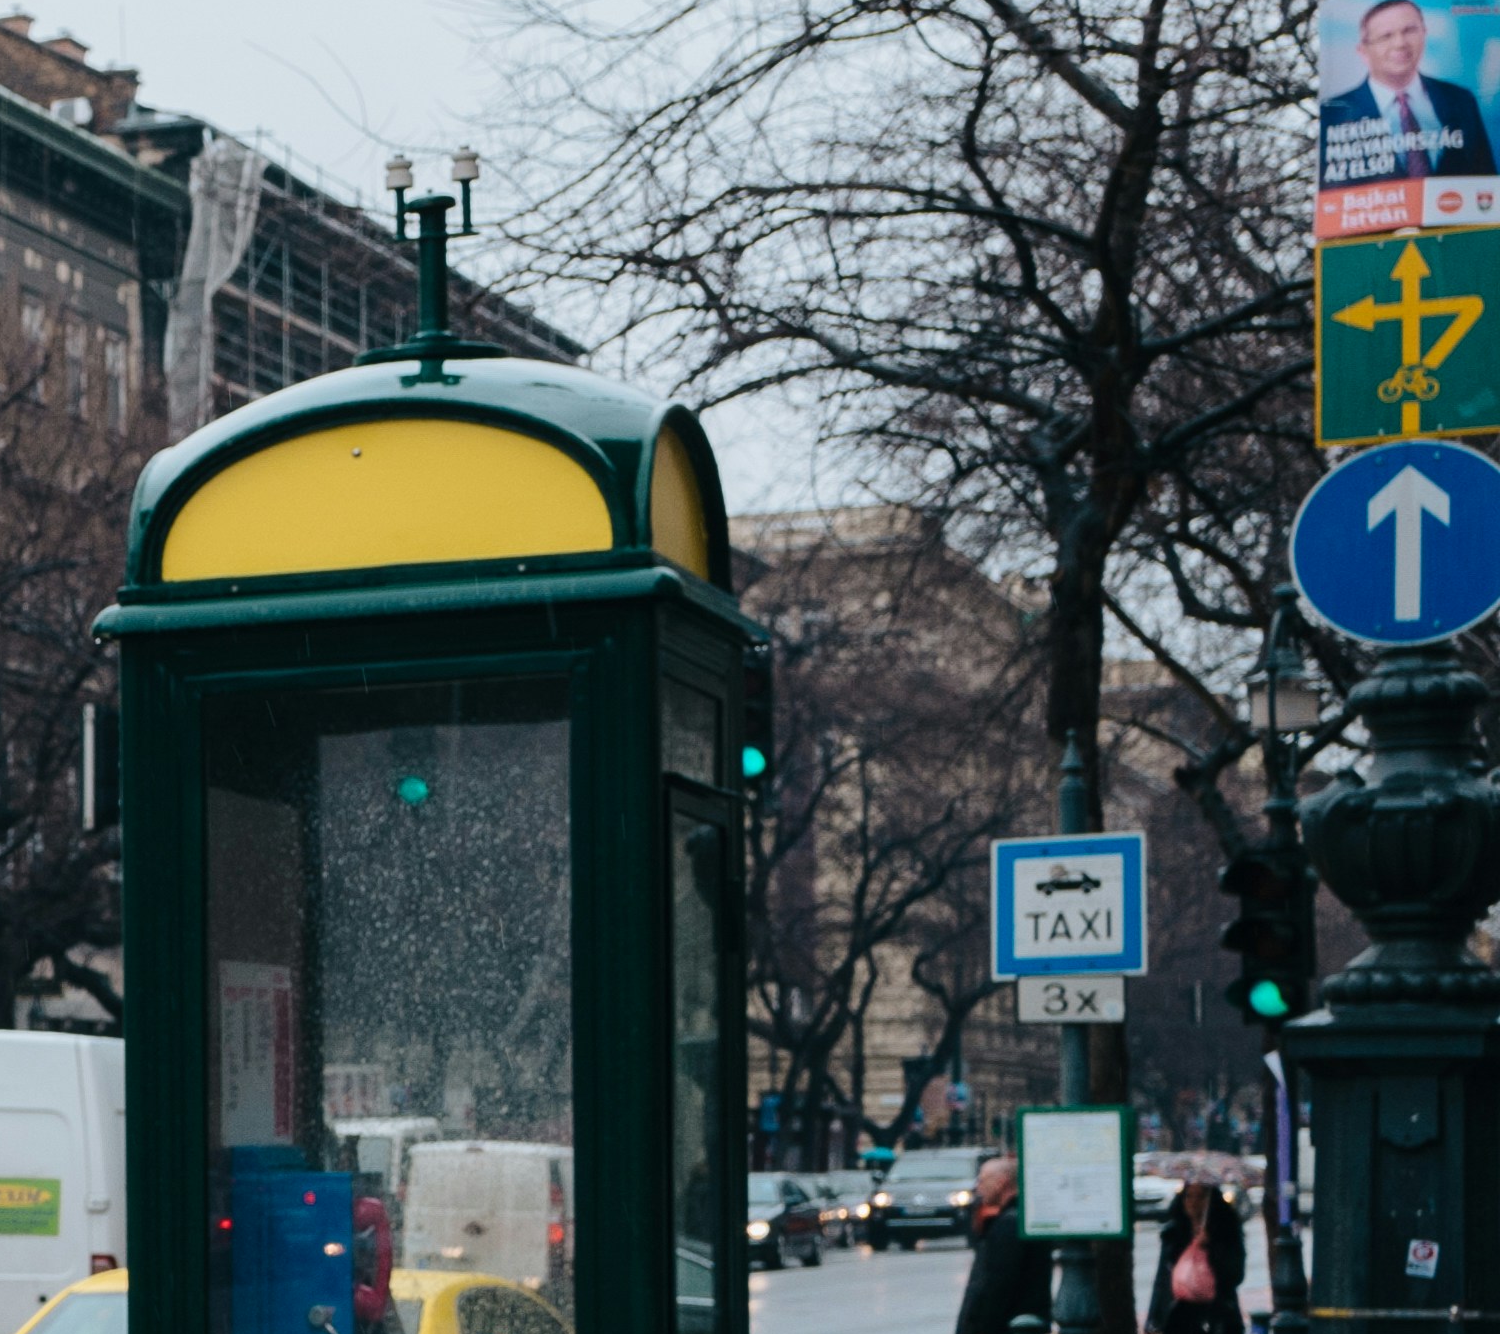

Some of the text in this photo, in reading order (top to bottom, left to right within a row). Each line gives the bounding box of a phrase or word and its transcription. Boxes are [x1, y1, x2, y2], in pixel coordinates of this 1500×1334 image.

[1326, 116, 1391, 143] NEKÜNK
[1326, 126, 1464, 162] MAGYARORSZÁG
[1323, 161, 1348, 183] AZ
[1342, 186, 1407, 211] Bajkai
[1341, 204, 1409, 230] István
[1025, 908, 1113, 942] TAXI
